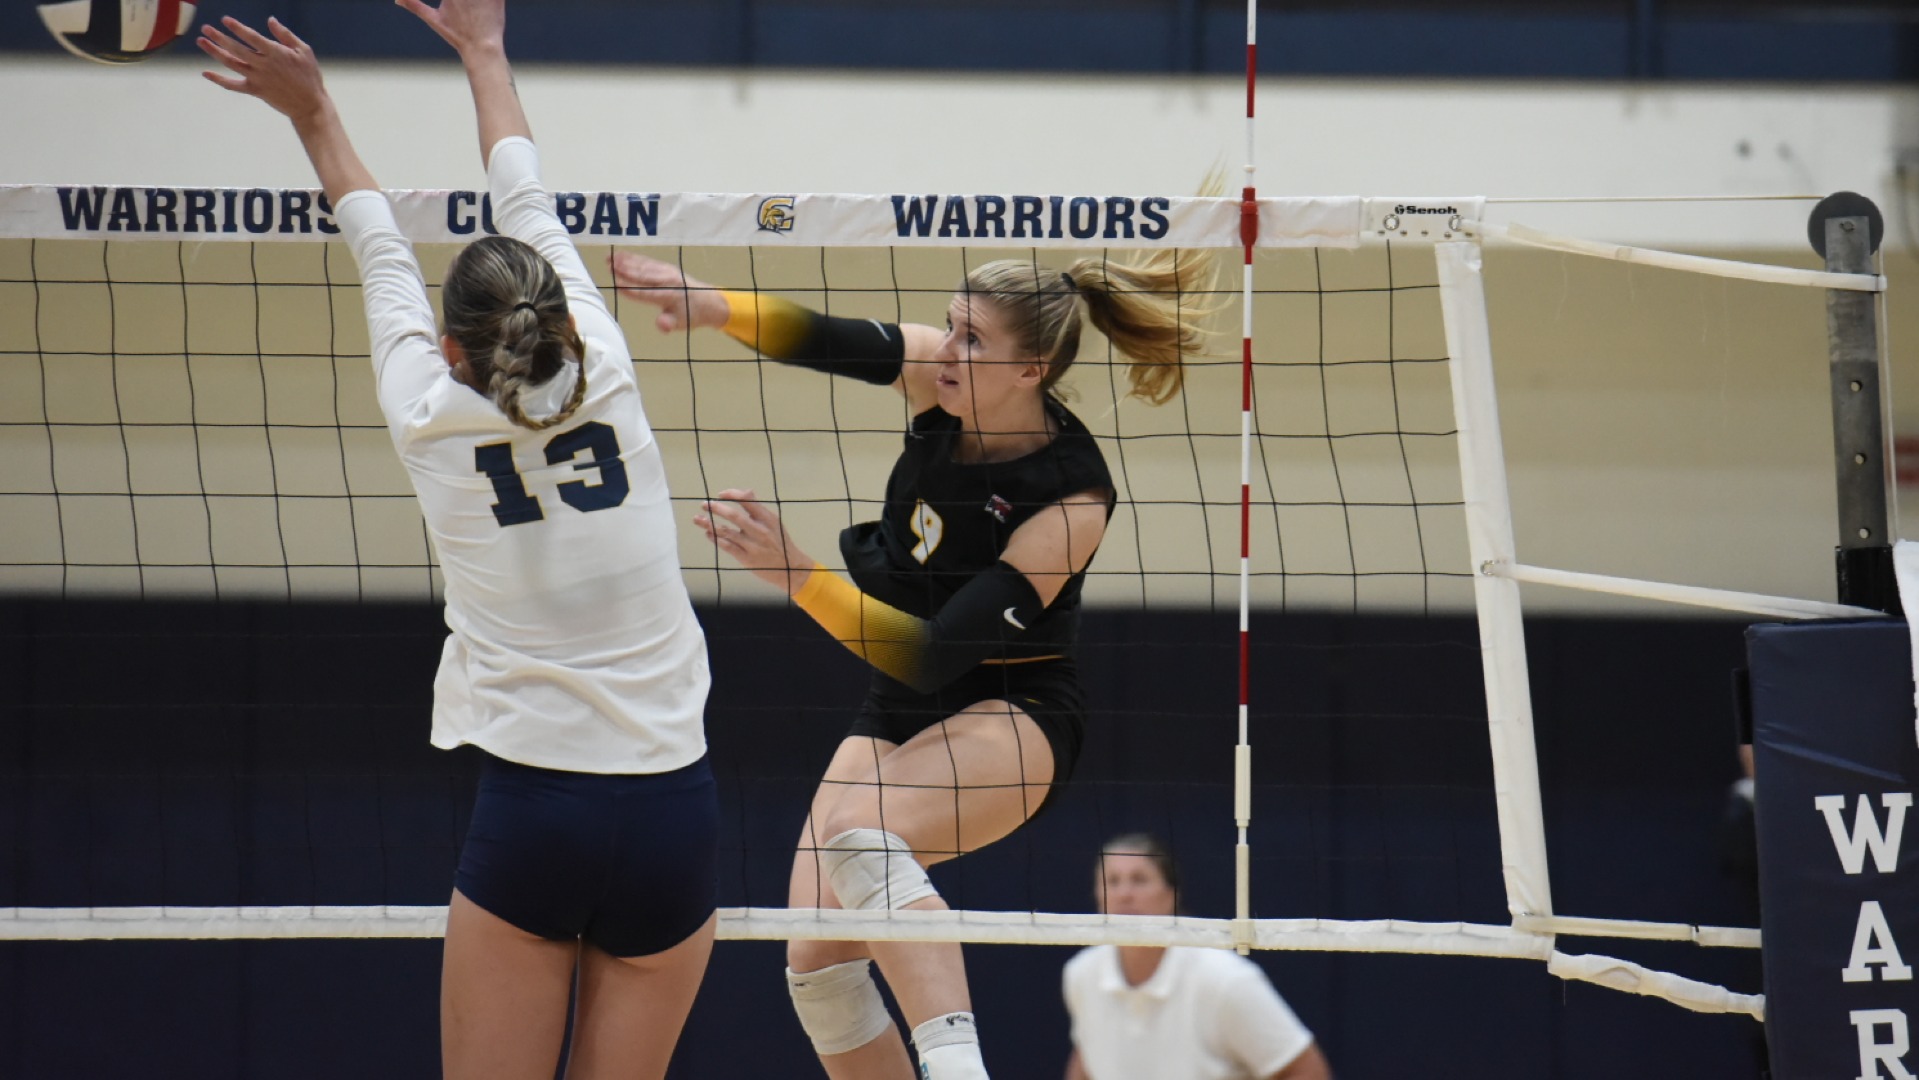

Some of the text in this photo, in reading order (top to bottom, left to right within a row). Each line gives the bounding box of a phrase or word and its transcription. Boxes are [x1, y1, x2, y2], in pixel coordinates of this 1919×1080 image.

[447, 190, 661, 236] CBAN
[891, 194, 1170, 240] WARRIORS
[1406, 206, 1458, 215] Senoh
[474, 420, 631, 528] 13
[910, 498, 943, 565] 9
